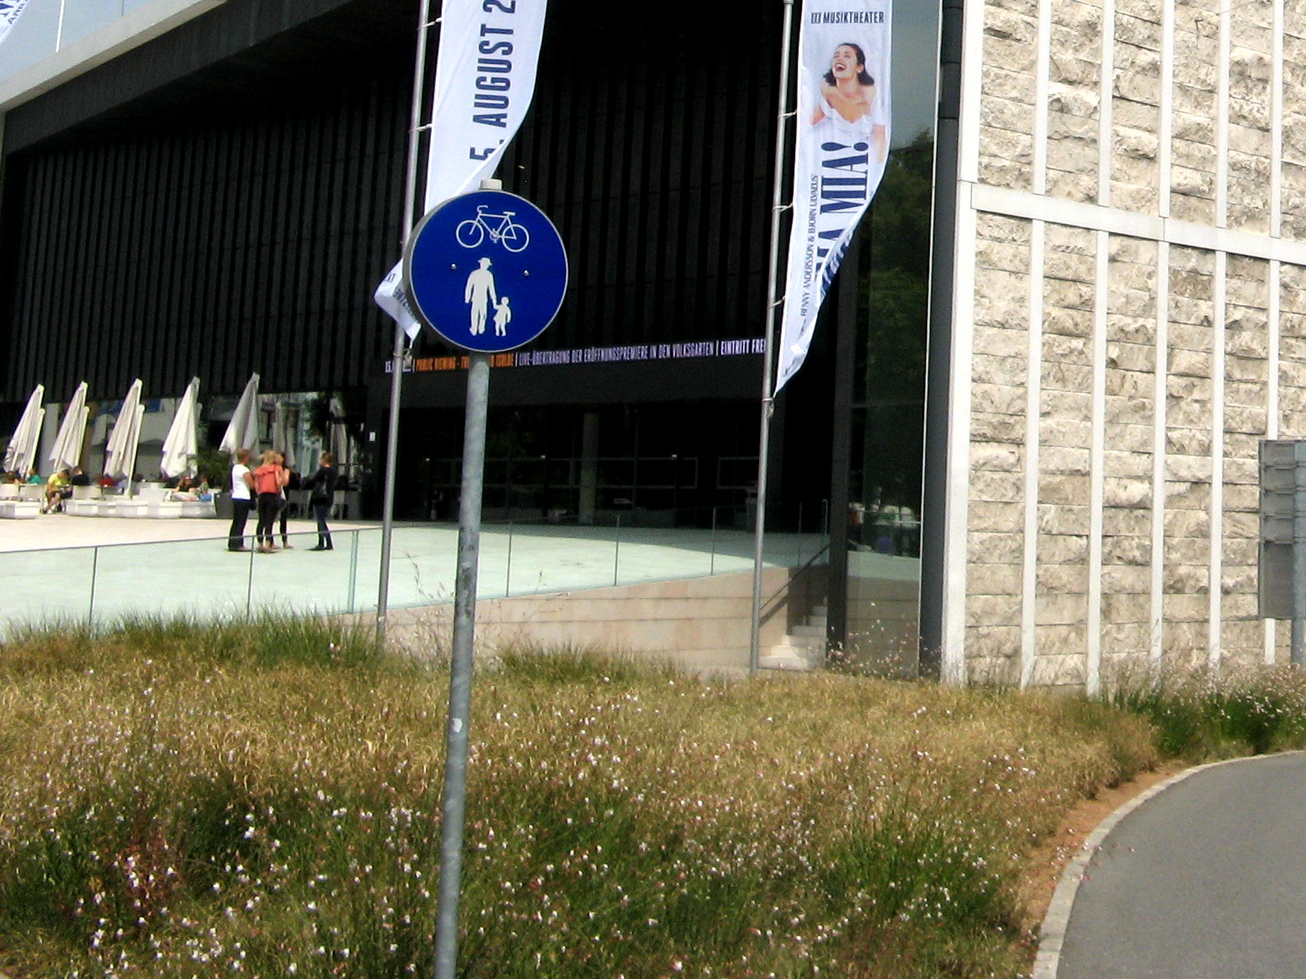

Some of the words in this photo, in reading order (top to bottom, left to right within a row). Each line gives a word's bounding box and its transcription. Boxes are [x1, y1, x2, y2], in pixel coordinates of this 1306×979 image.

[823, 11, 885, 24] MUSIKTHEATER
[472, 23, 514, 128] AUGUST
[820, 142, 869, 215] MIA!
[572, 349, 583, 363] DER
[650, 345, 657, 359] IN
[658, 344, 670, 359] DEN
